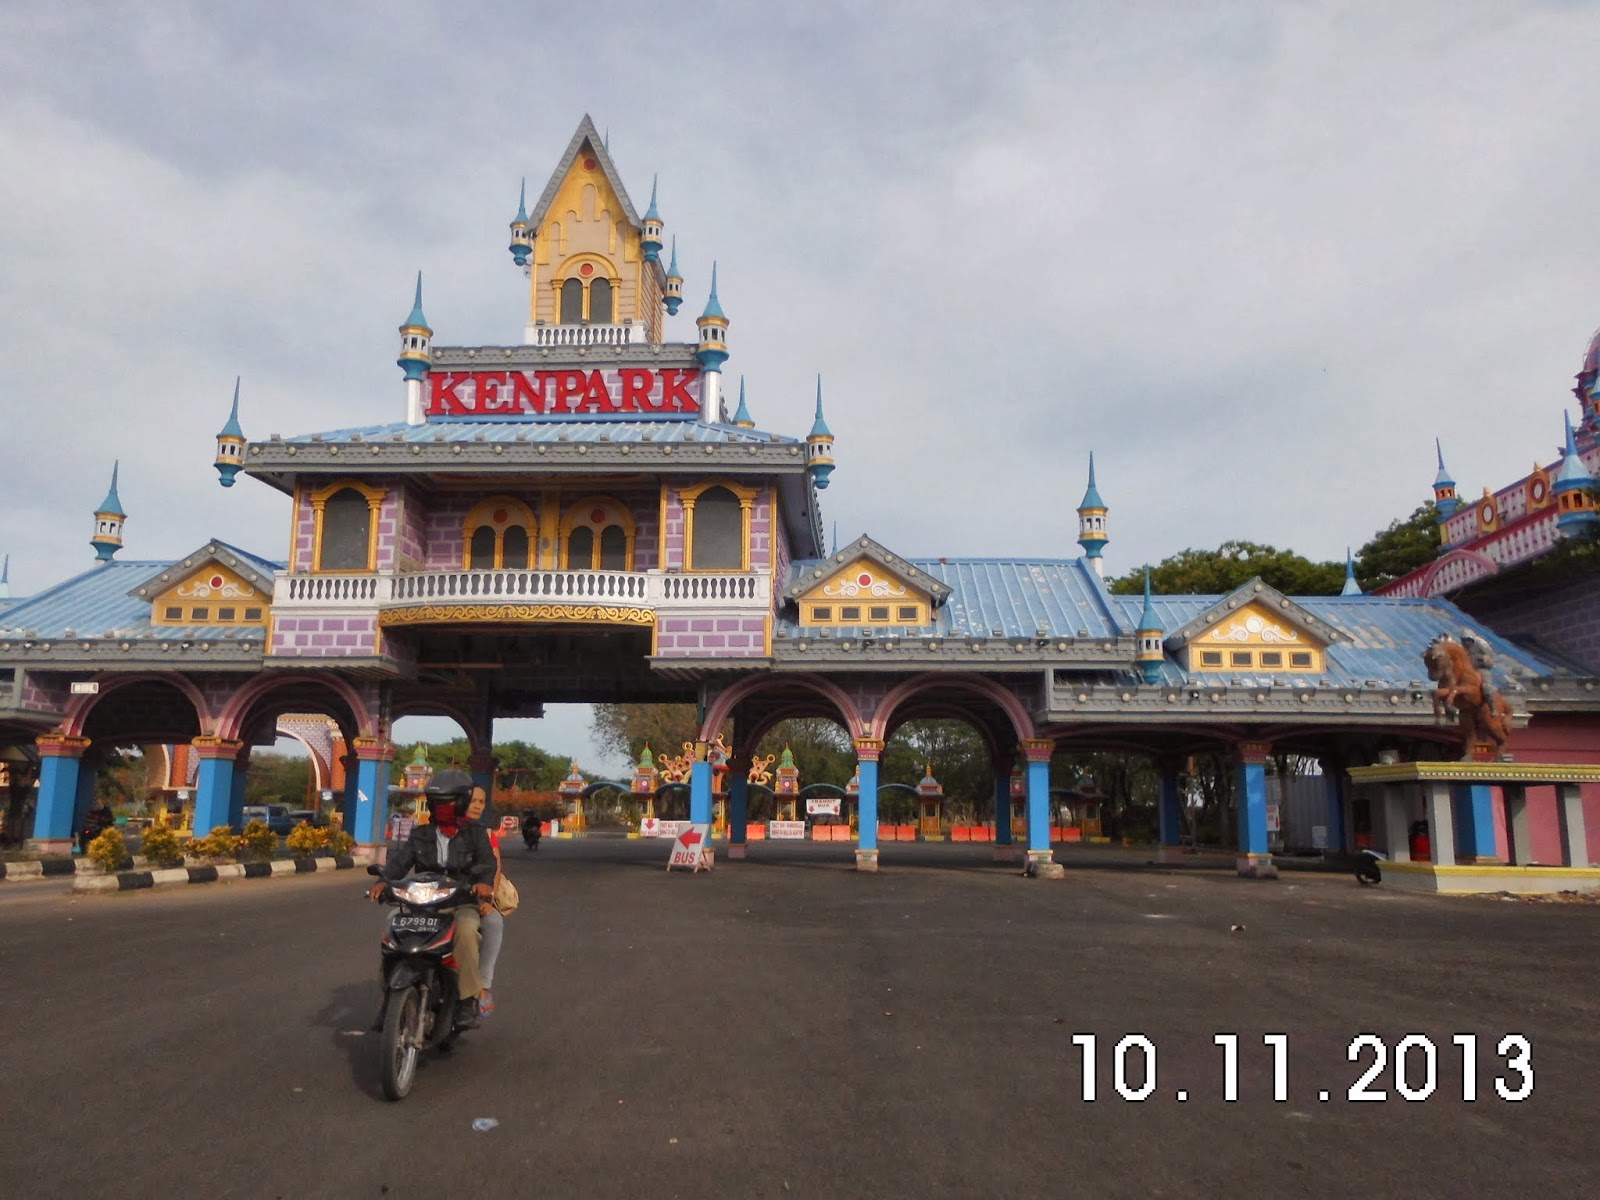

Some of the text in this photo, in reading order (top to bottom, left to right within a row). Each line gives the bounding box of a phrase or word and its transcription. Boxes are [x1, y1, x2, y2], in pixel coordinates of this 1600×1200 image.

[425, 368, 700, 415] KENPARK
[674, 851, 696, 864] BUS
[400, 916, 426, 927] 6799
